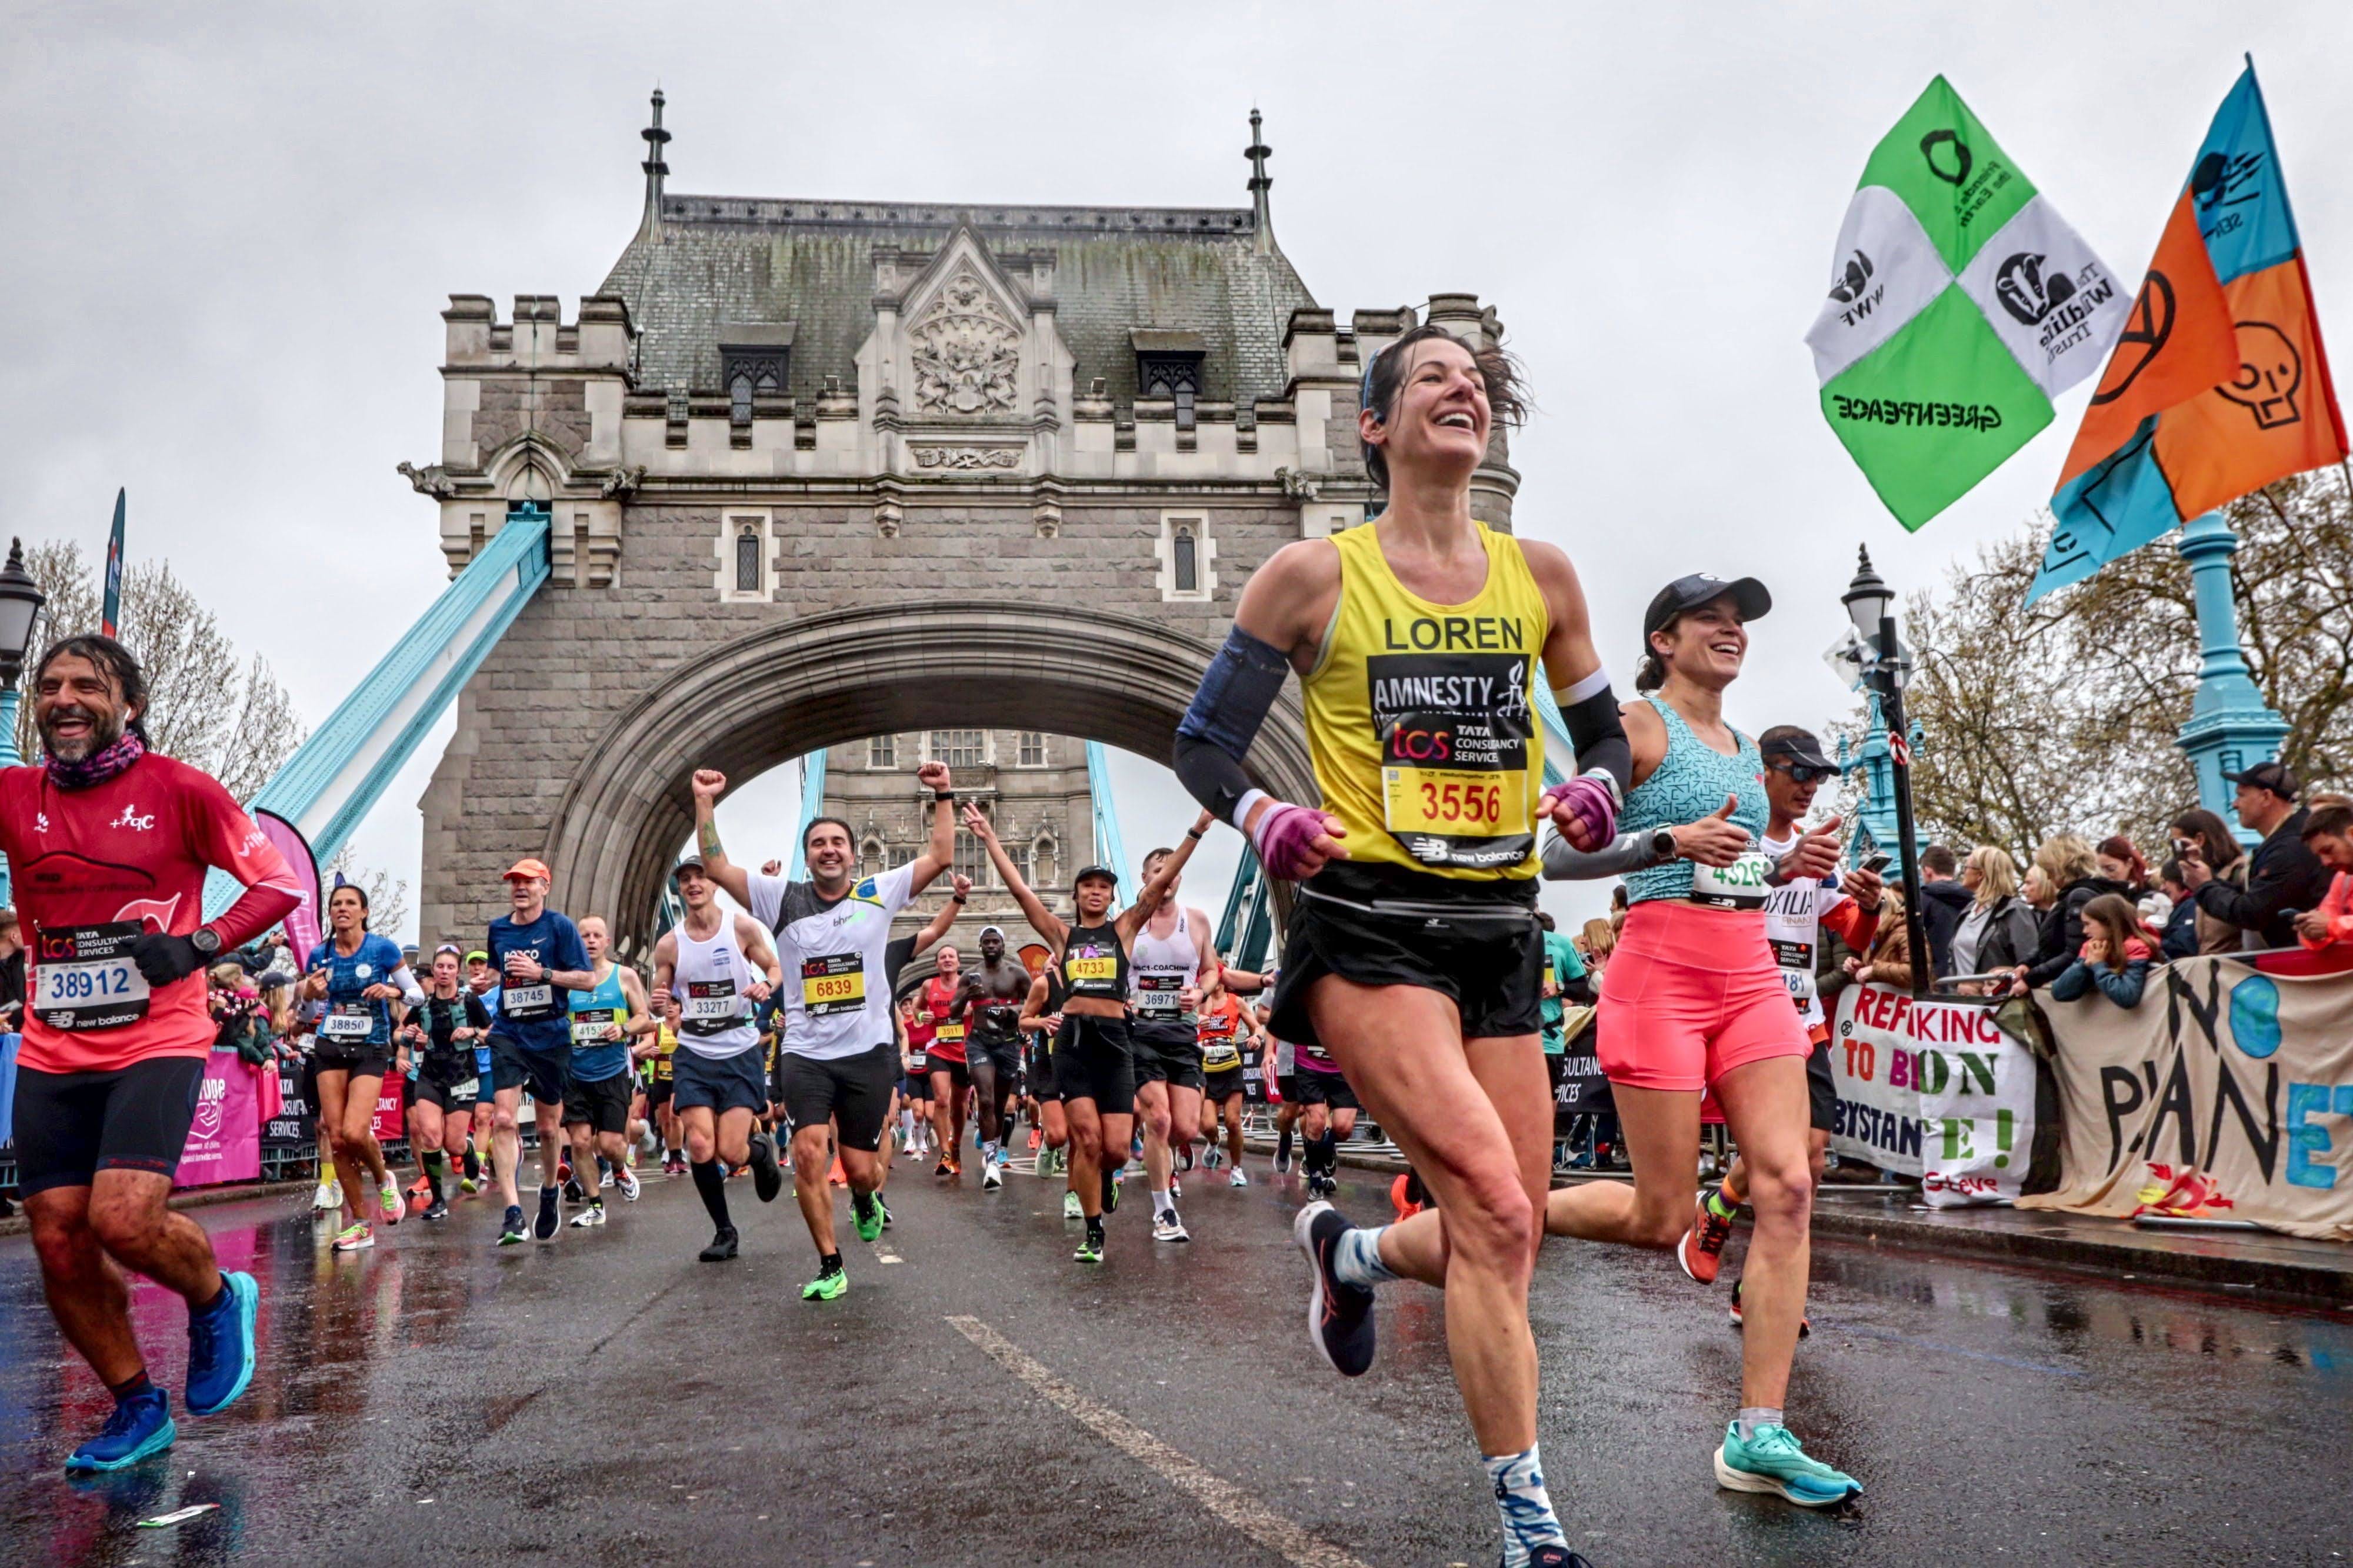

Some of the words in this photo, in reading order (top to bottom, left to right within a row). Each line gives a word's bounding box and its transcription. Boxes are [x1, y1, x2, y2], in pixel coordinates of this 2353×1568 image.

[1385, 618, 1522, 650] LOREN
[1374, 676, 1494, 709] AMNESTY
[1394, 722, 1449, 760] tcs
[1457, 725, 1490, 736] TATA
[1421, 783, 1500, 823] 3556
[1452, 853, 1475, 862] new
[1477, 850, 1525, 863] balance
[42, 934, 76, 959] tcs
[1076, 961, 1104, 975] 4733
[51, 968, 130, 999] 38912
[816, 980, 852, 996] 6839
[511, 990, 544, 1003] 38745
[1145, 994, 1176, 1005] 36971
[696, 1001, 729, 1013] 33277
[1854, 986, 1915, 1037] REF
[76, 1019, 96, 1027] new
[98, 1013, 139, 1026] balance
[331, 1019, 365, 1030] 38850
[1844, 1039, 1875, 1082] TO
[269, 1120, 300, 1138] SERVICES
